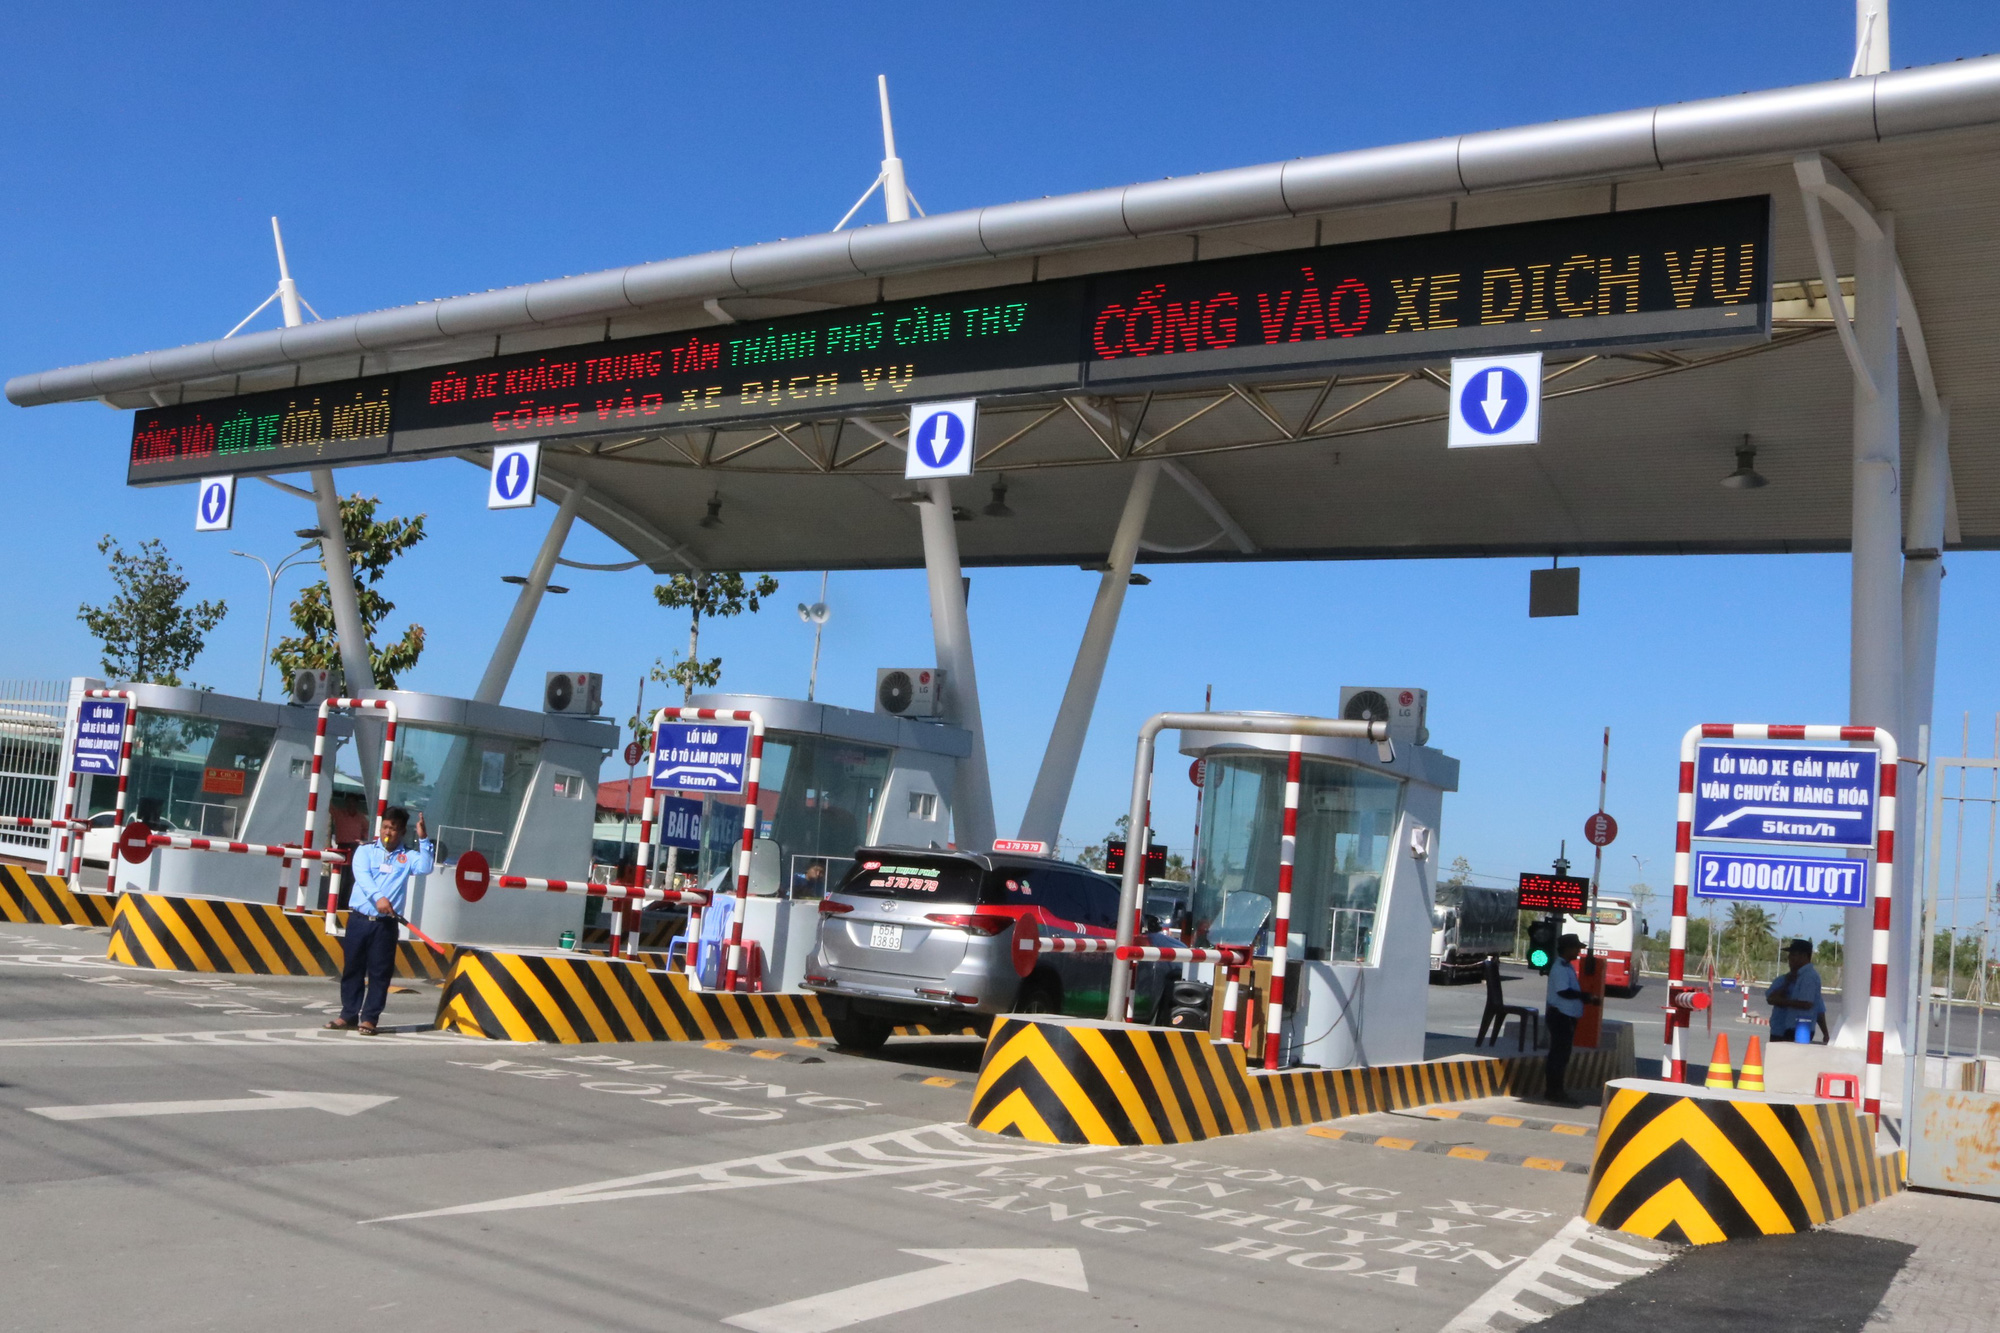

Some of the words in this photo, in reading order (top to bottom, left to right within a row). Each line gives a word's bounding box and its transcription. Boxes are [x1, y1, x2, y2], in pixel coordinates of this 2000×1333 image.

[1093, 284, 1239, 360] CỔNG
[1257, 267, 1371, 344] VÀO
[1385, 274, 1461, 334] XE
[1480, 254, 1641, 333] DỊCH
[1664, 243, 1754, 317] VỤ
[472, 373, 499, 399] XE
[505, 358, 577, 394] KHÁCH
[585, 350, 663, 385] TRUNG
[671, 337, 720, 374] TÂM
[729, 326, 816, 366] THÀNH
[963, 303, 1028, 338] THƠ
[596, 388, 663, 421] VÀO
[678, 386, 723, 412] XE
[740, 373, 839, 407] DỊCH
[861, 364, 914, 394] VỤ
[181, 413, 215, 460] VÀO
[254, 414, 280, 452] XE
[919, 686, 928, 694] LG
[93, 705, 102, 718] LỐI
[102, 706, 113, 719] VÀO
[1398, 709, 1411, 717] LG
[686, 728, 700, 744] LỐI
[701, 729, 718, 745] VÀO
[80, 760, 101, 768] 5km/h
[629, 745, 637, 764] STOP
[658, 749, 670, 761] XE
[671, 747, 677, 762] Ô
[679, 748, 689, 763] TÔ
[690, 749, 708, 764] LÀM
[709, 752, 731, 766] DỊCH
[731, 753, 742, 768] VỤ
[1713, 753, 1735, 774] LỐI
[1739, 755, 1768, 776] VÀO
[1771, 760, 1789, 776] XE
[1792, 754, 1823, 778] GẮN
[1826, 759, 1860, 779] MÁY
[679, 775, 717, 787] 5km/h
[1701, 780, 1730, 802] VẬN
[1733, 780, 1789, 802] CHUYỂN
[1793, 784, 1834, 805] HÀNG
[1837, 783, 1869, 806] HÓA
[667, 807, 689, 839] BÃI
[1594, 816, 1607, 843] STOP
[1762, 820, 1836, 836] 5km/h
[879, 924, 895, 936] 65A
[446, 1059, 592, 1080] XE
[579, 1081, 667, 1095] Ô
[641, 1093, 787, 1121] TÔ
[552, 1054, 882, 1111] ĐƯỜNG
[1110, 1150, 1402, 1200] ĐƯỜNG
[1422, 1199, 1553, 1224] XE
[892, 1179, 1162, 1234] HÀNG
[1202, 1236, 1419, 1287] HÓA
[1139, 1199, 1529, 1270] CHUYỂN
